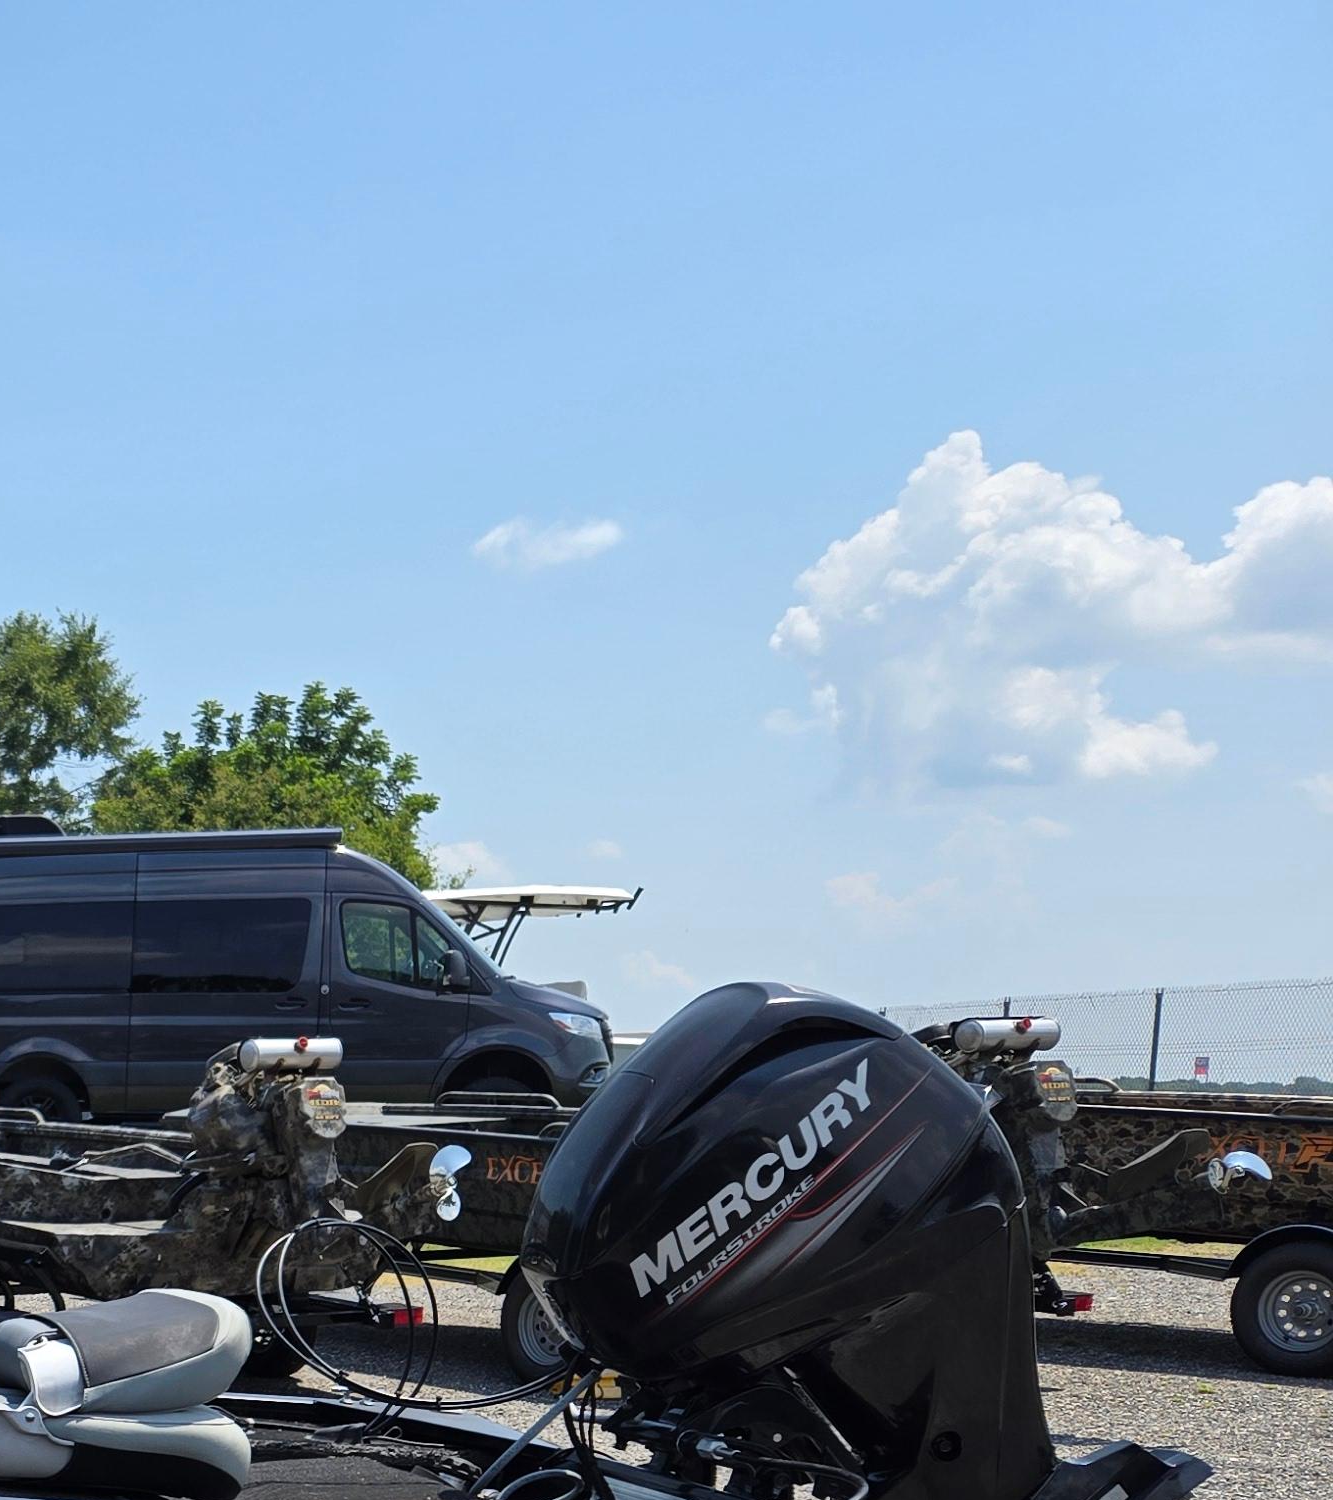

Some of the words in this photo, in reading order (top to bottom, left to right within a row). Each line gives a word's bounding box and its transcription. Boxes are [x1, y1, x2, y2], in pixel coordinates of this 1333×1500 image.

[486, 1155, 543, 1185] EXCE
[629, 1058, 871, 1298] MERCURY
[665, 1174, 816, 1305] FOURSTROKE
